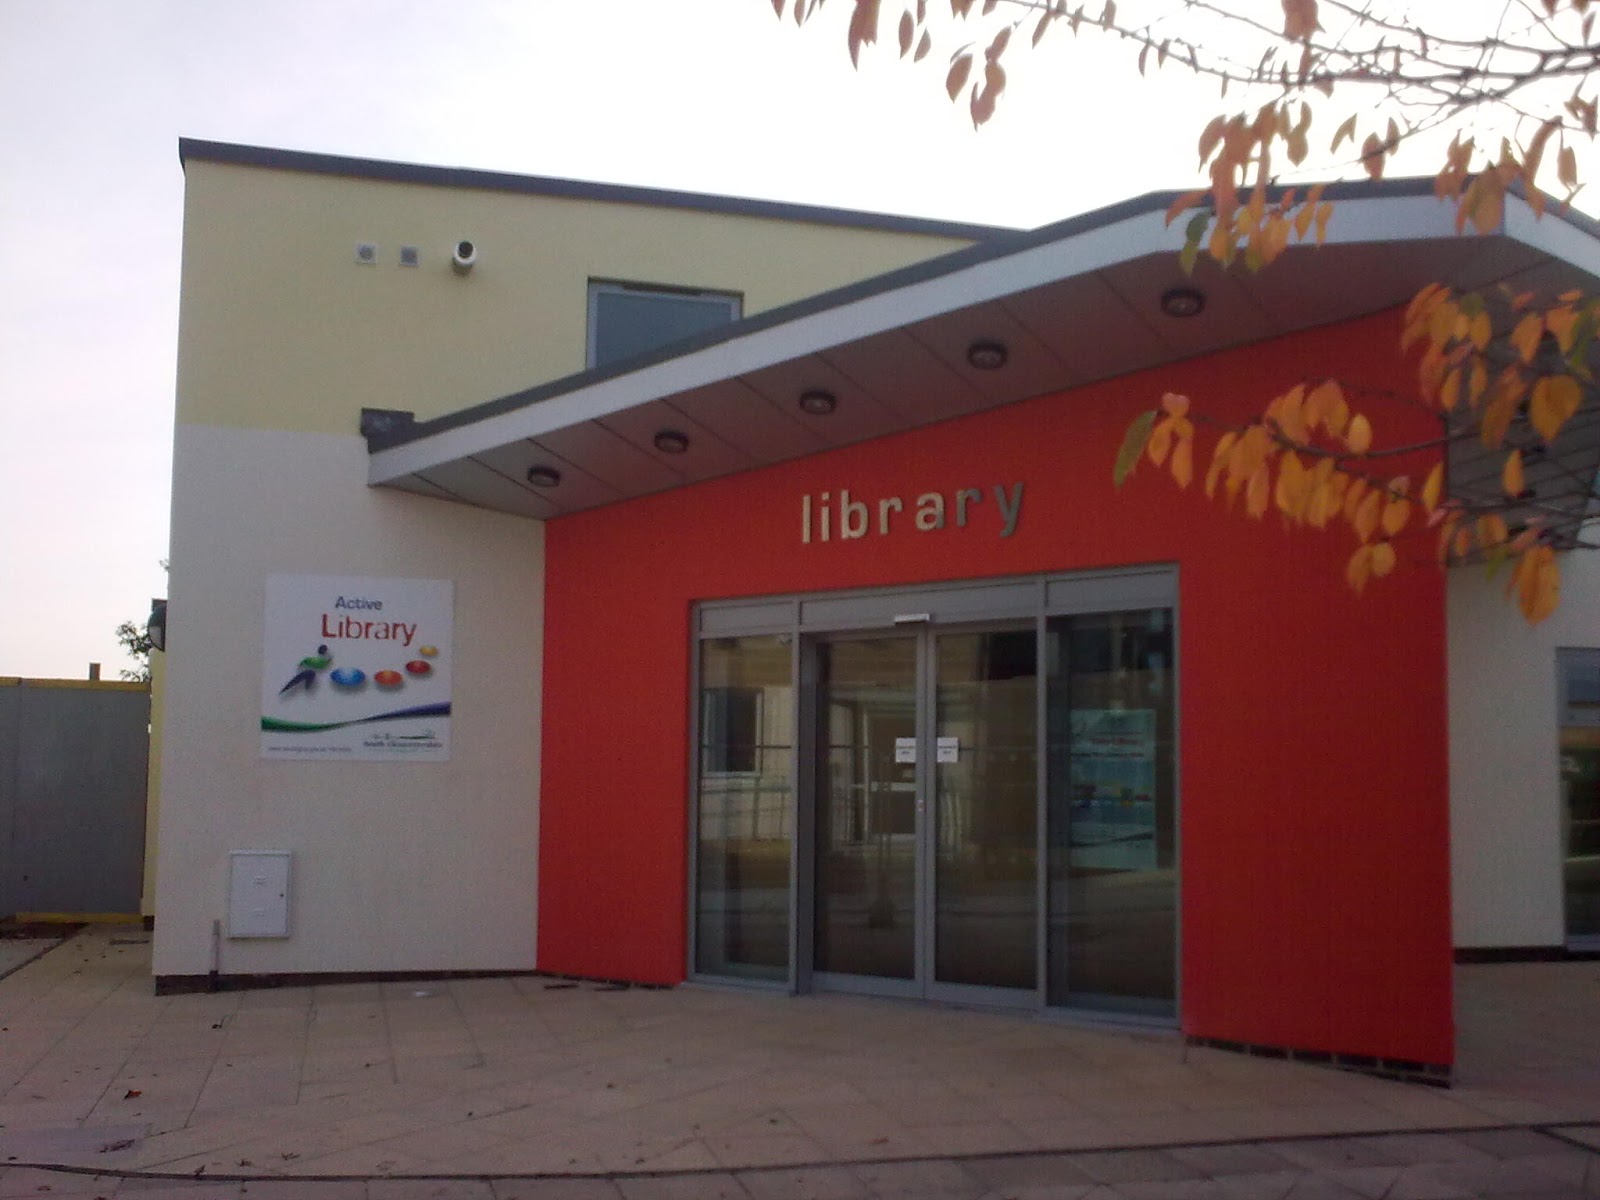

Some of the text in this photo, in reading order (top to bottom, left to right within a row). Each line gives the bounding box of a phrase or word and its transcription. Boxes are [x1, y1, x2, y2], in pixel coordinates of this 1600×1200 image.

[802, 482, 1024, 543] library
[335, 596, 383, 610] Active
[321, 613, 417, 647] Library
